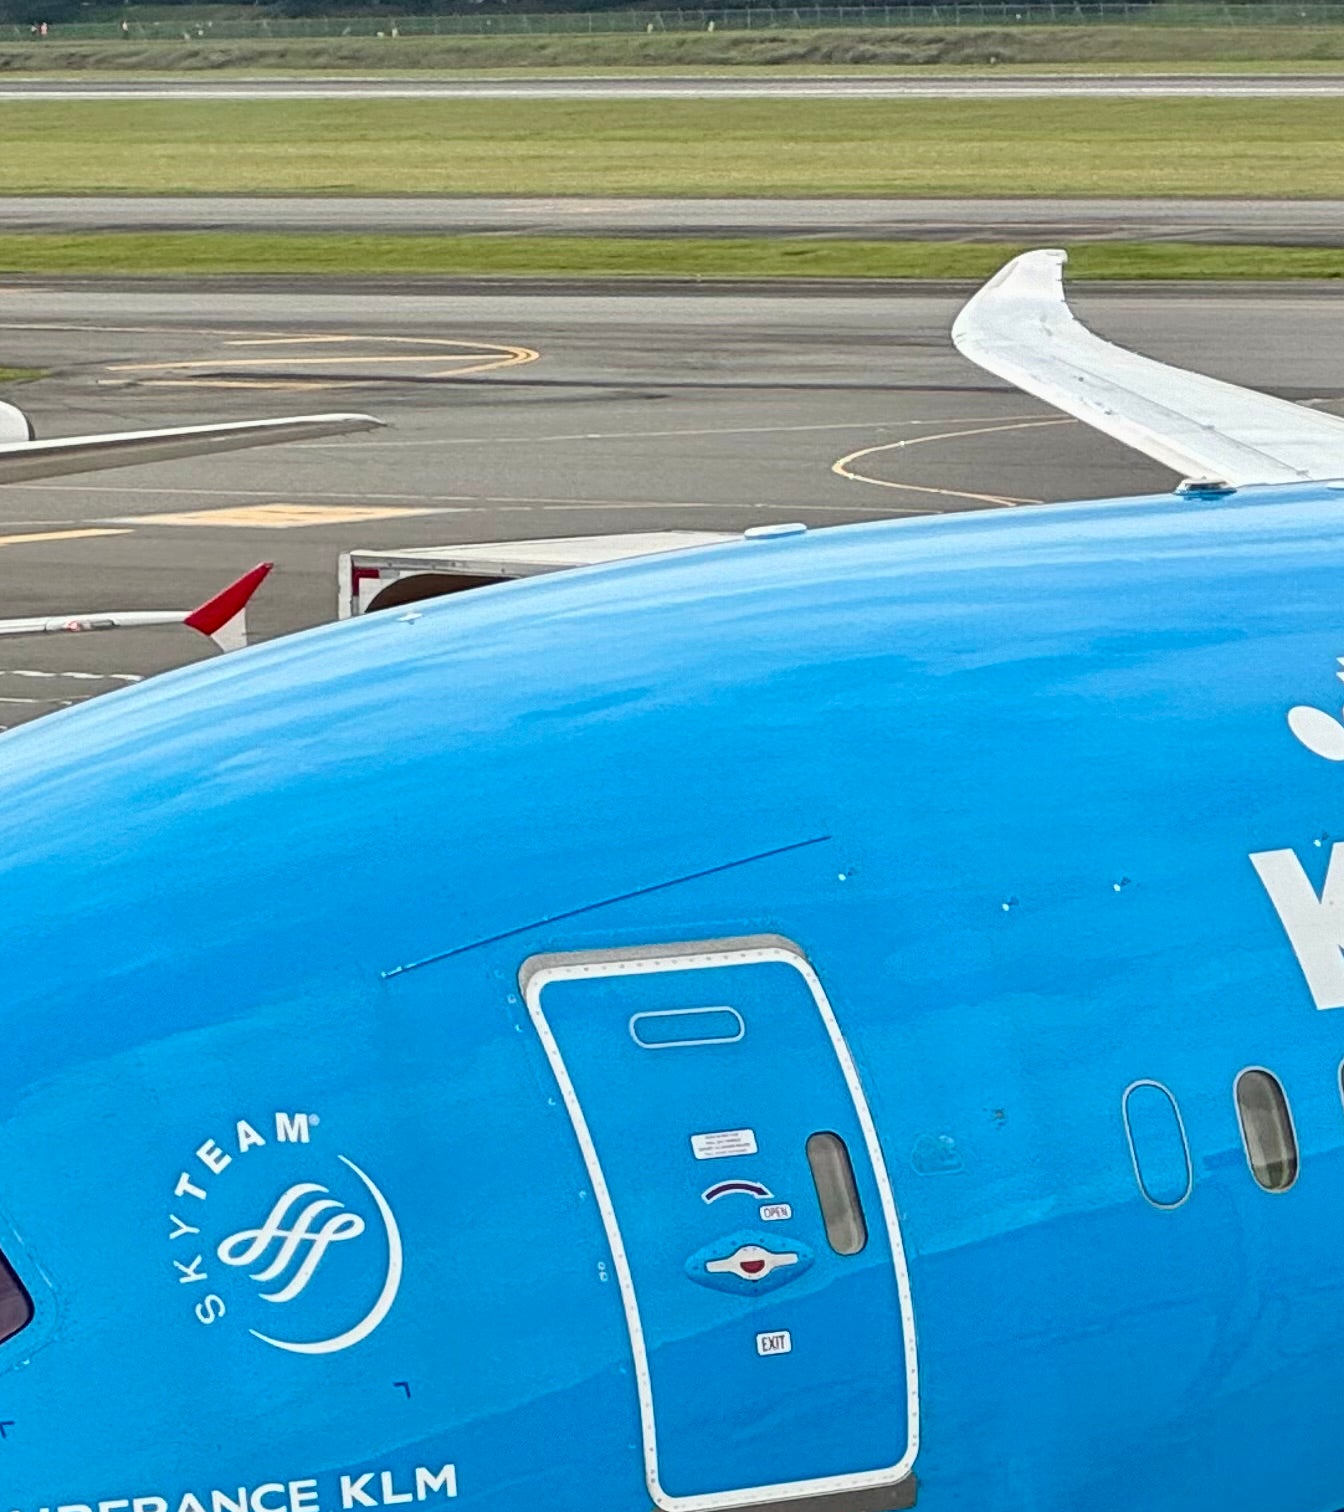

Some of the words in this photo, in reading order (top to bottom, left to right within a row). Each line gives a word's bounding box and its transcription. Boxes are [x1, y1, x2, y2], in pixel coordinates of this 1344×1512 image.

[169, 1112, 311, 1325] SKYTEAM
[763, 1206, 789, 1219] OPEN
[761, 1334, 786, 1353] EXIT
[340, 1463, 458, 1509] KLM
